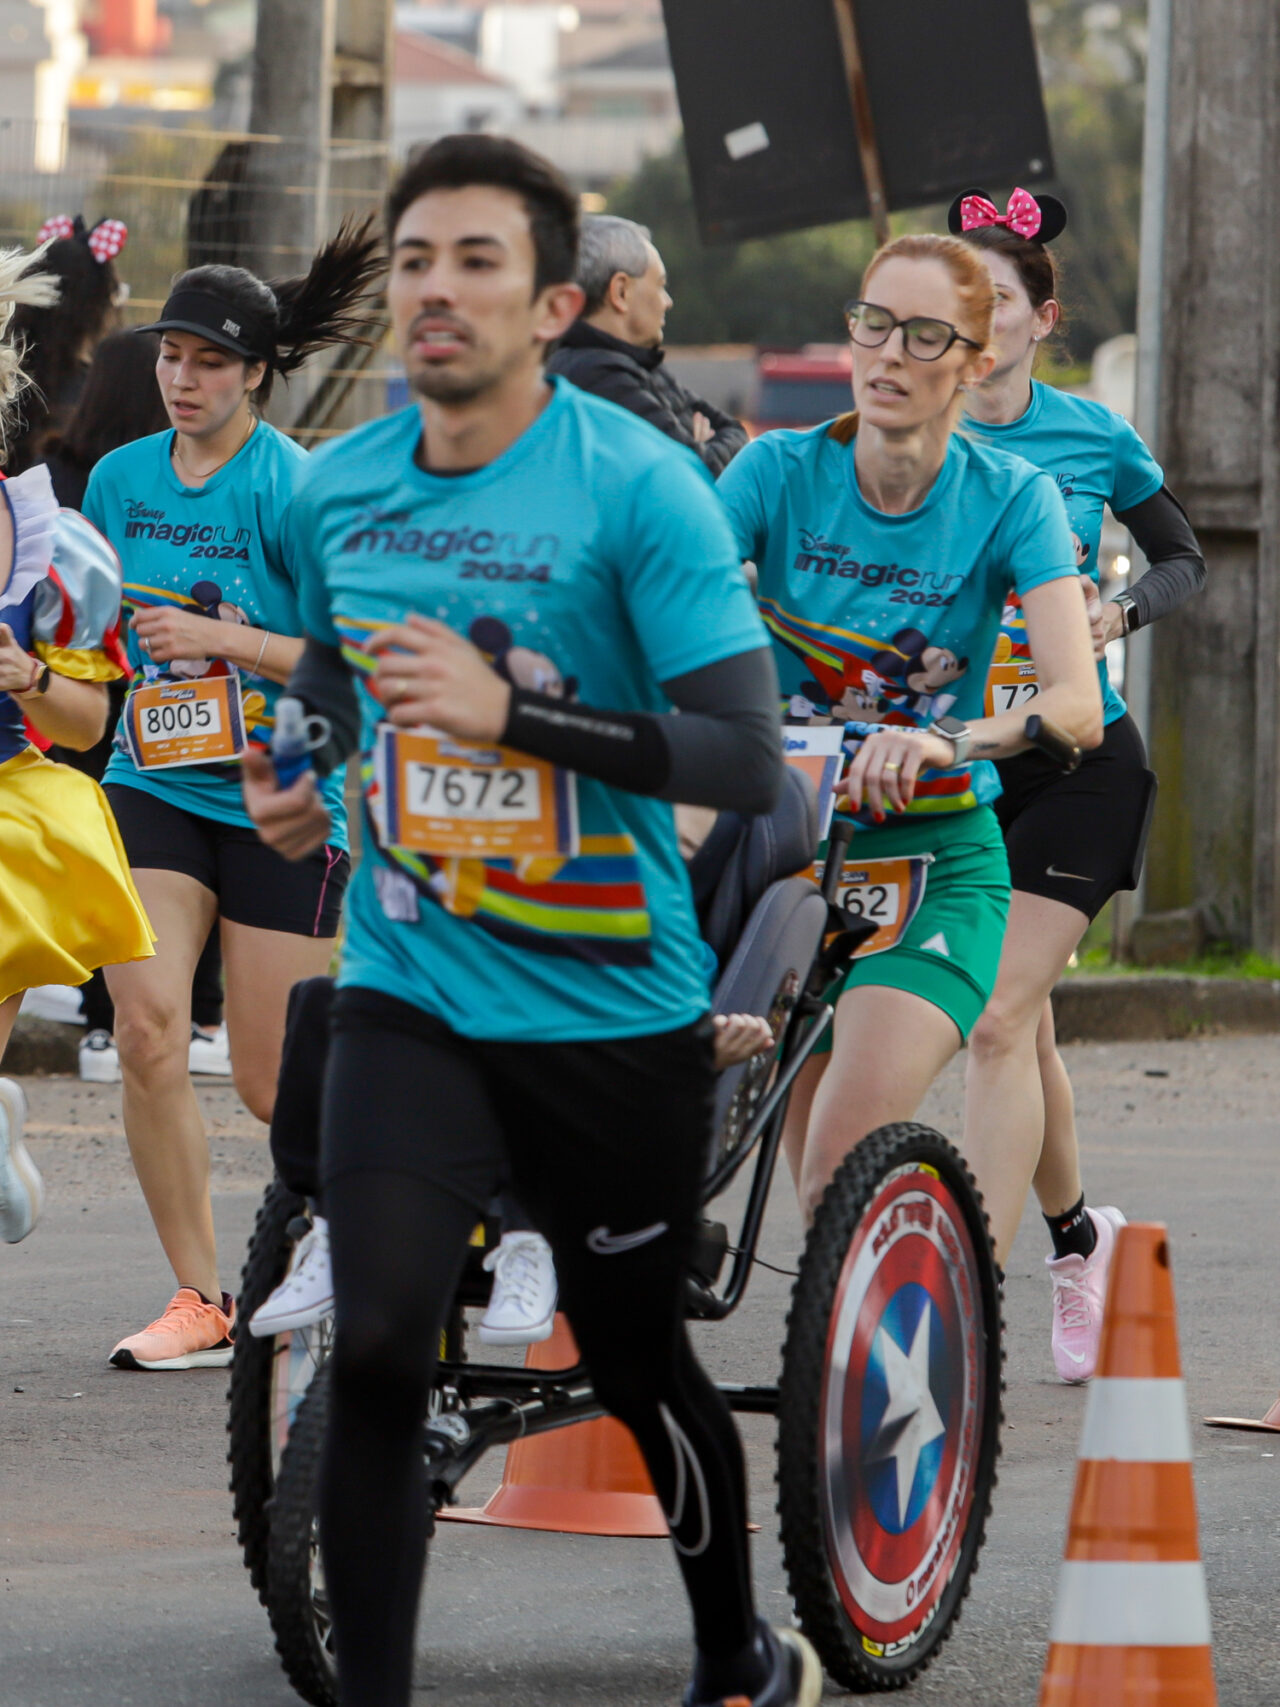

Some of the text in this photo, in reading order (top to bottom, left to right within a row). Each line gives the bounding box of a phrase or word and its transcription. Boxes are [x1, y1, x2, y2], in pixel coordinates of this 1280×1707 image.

[189, 546, 249, 560] 2024
[458, 560, 551, 583] 2024
[1001, 683, 1039, 710] 72
[147, 701, 211, 734] 8005
[418, 766, 525, 808] 7672
[843, 885, 888, 917] 62
